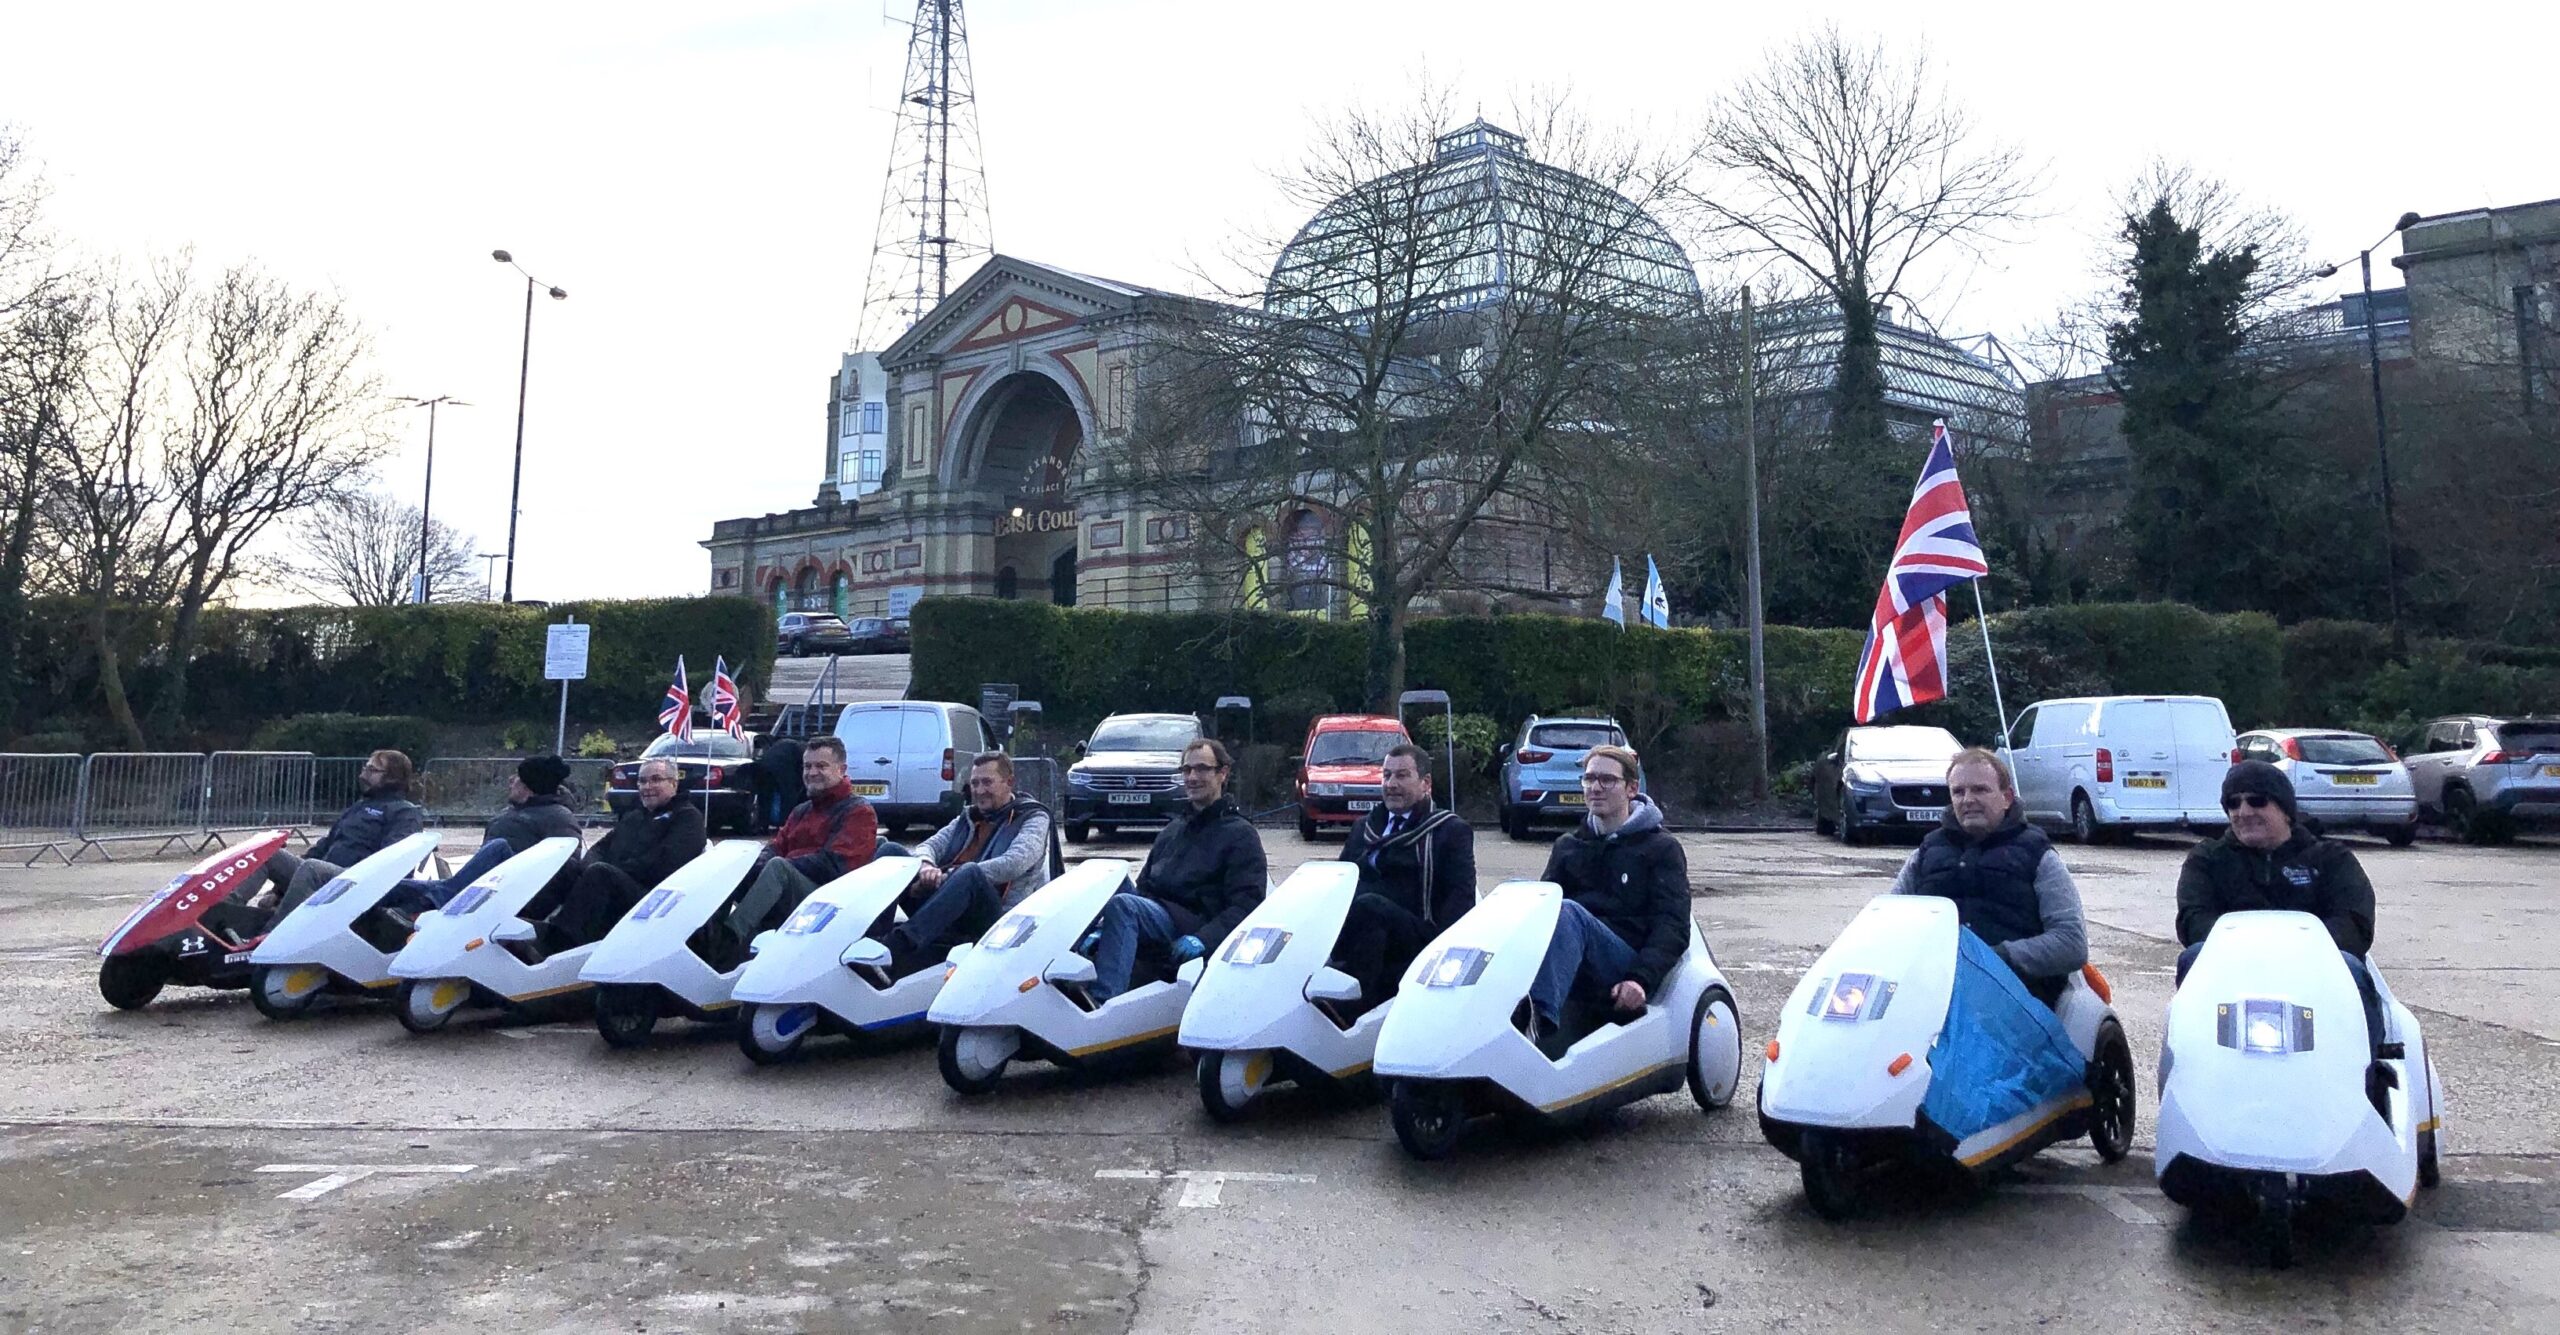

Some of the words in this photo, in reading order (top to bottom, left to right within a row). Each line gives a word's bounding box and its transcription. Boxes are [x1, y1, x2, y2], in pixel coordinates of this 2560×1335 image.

[1020, 455, 1068, 493] ALEXANDR
[1031, 483, 1060, 494] PALACE
[995, 511, 1035, 537] East
[176, 892, 199, 911] C5
[202, 852, 258, 891] DEPOT
